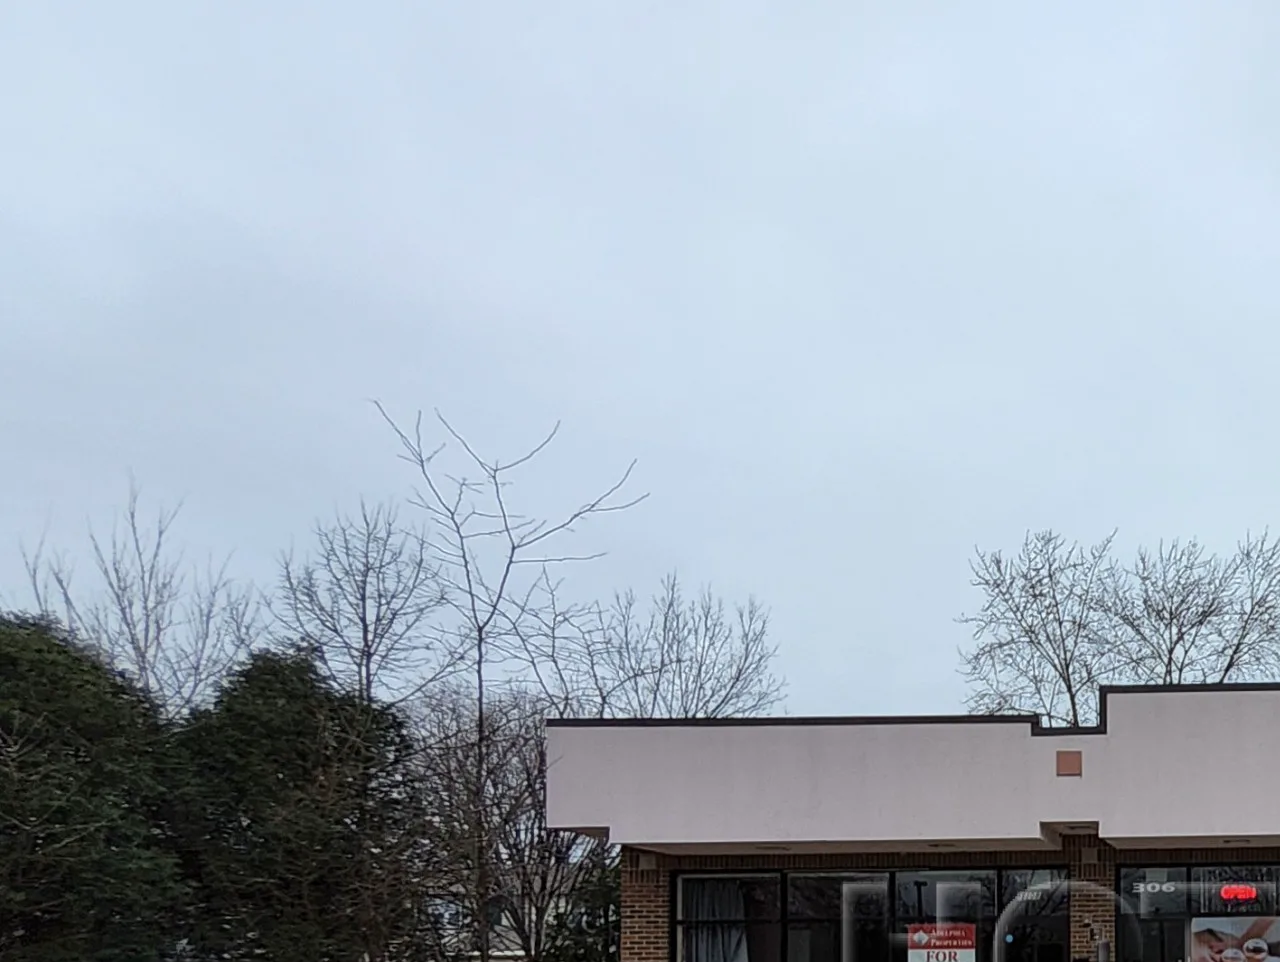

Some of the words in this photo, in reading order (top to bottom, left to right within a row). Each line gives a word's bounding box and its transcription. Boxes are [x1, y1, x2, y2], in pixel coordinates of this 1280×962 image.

[1132, 882, 1175, 893] 306
[1221, 884, 1256, 899] OPEN
[926, 951, 958, 962] FOR
